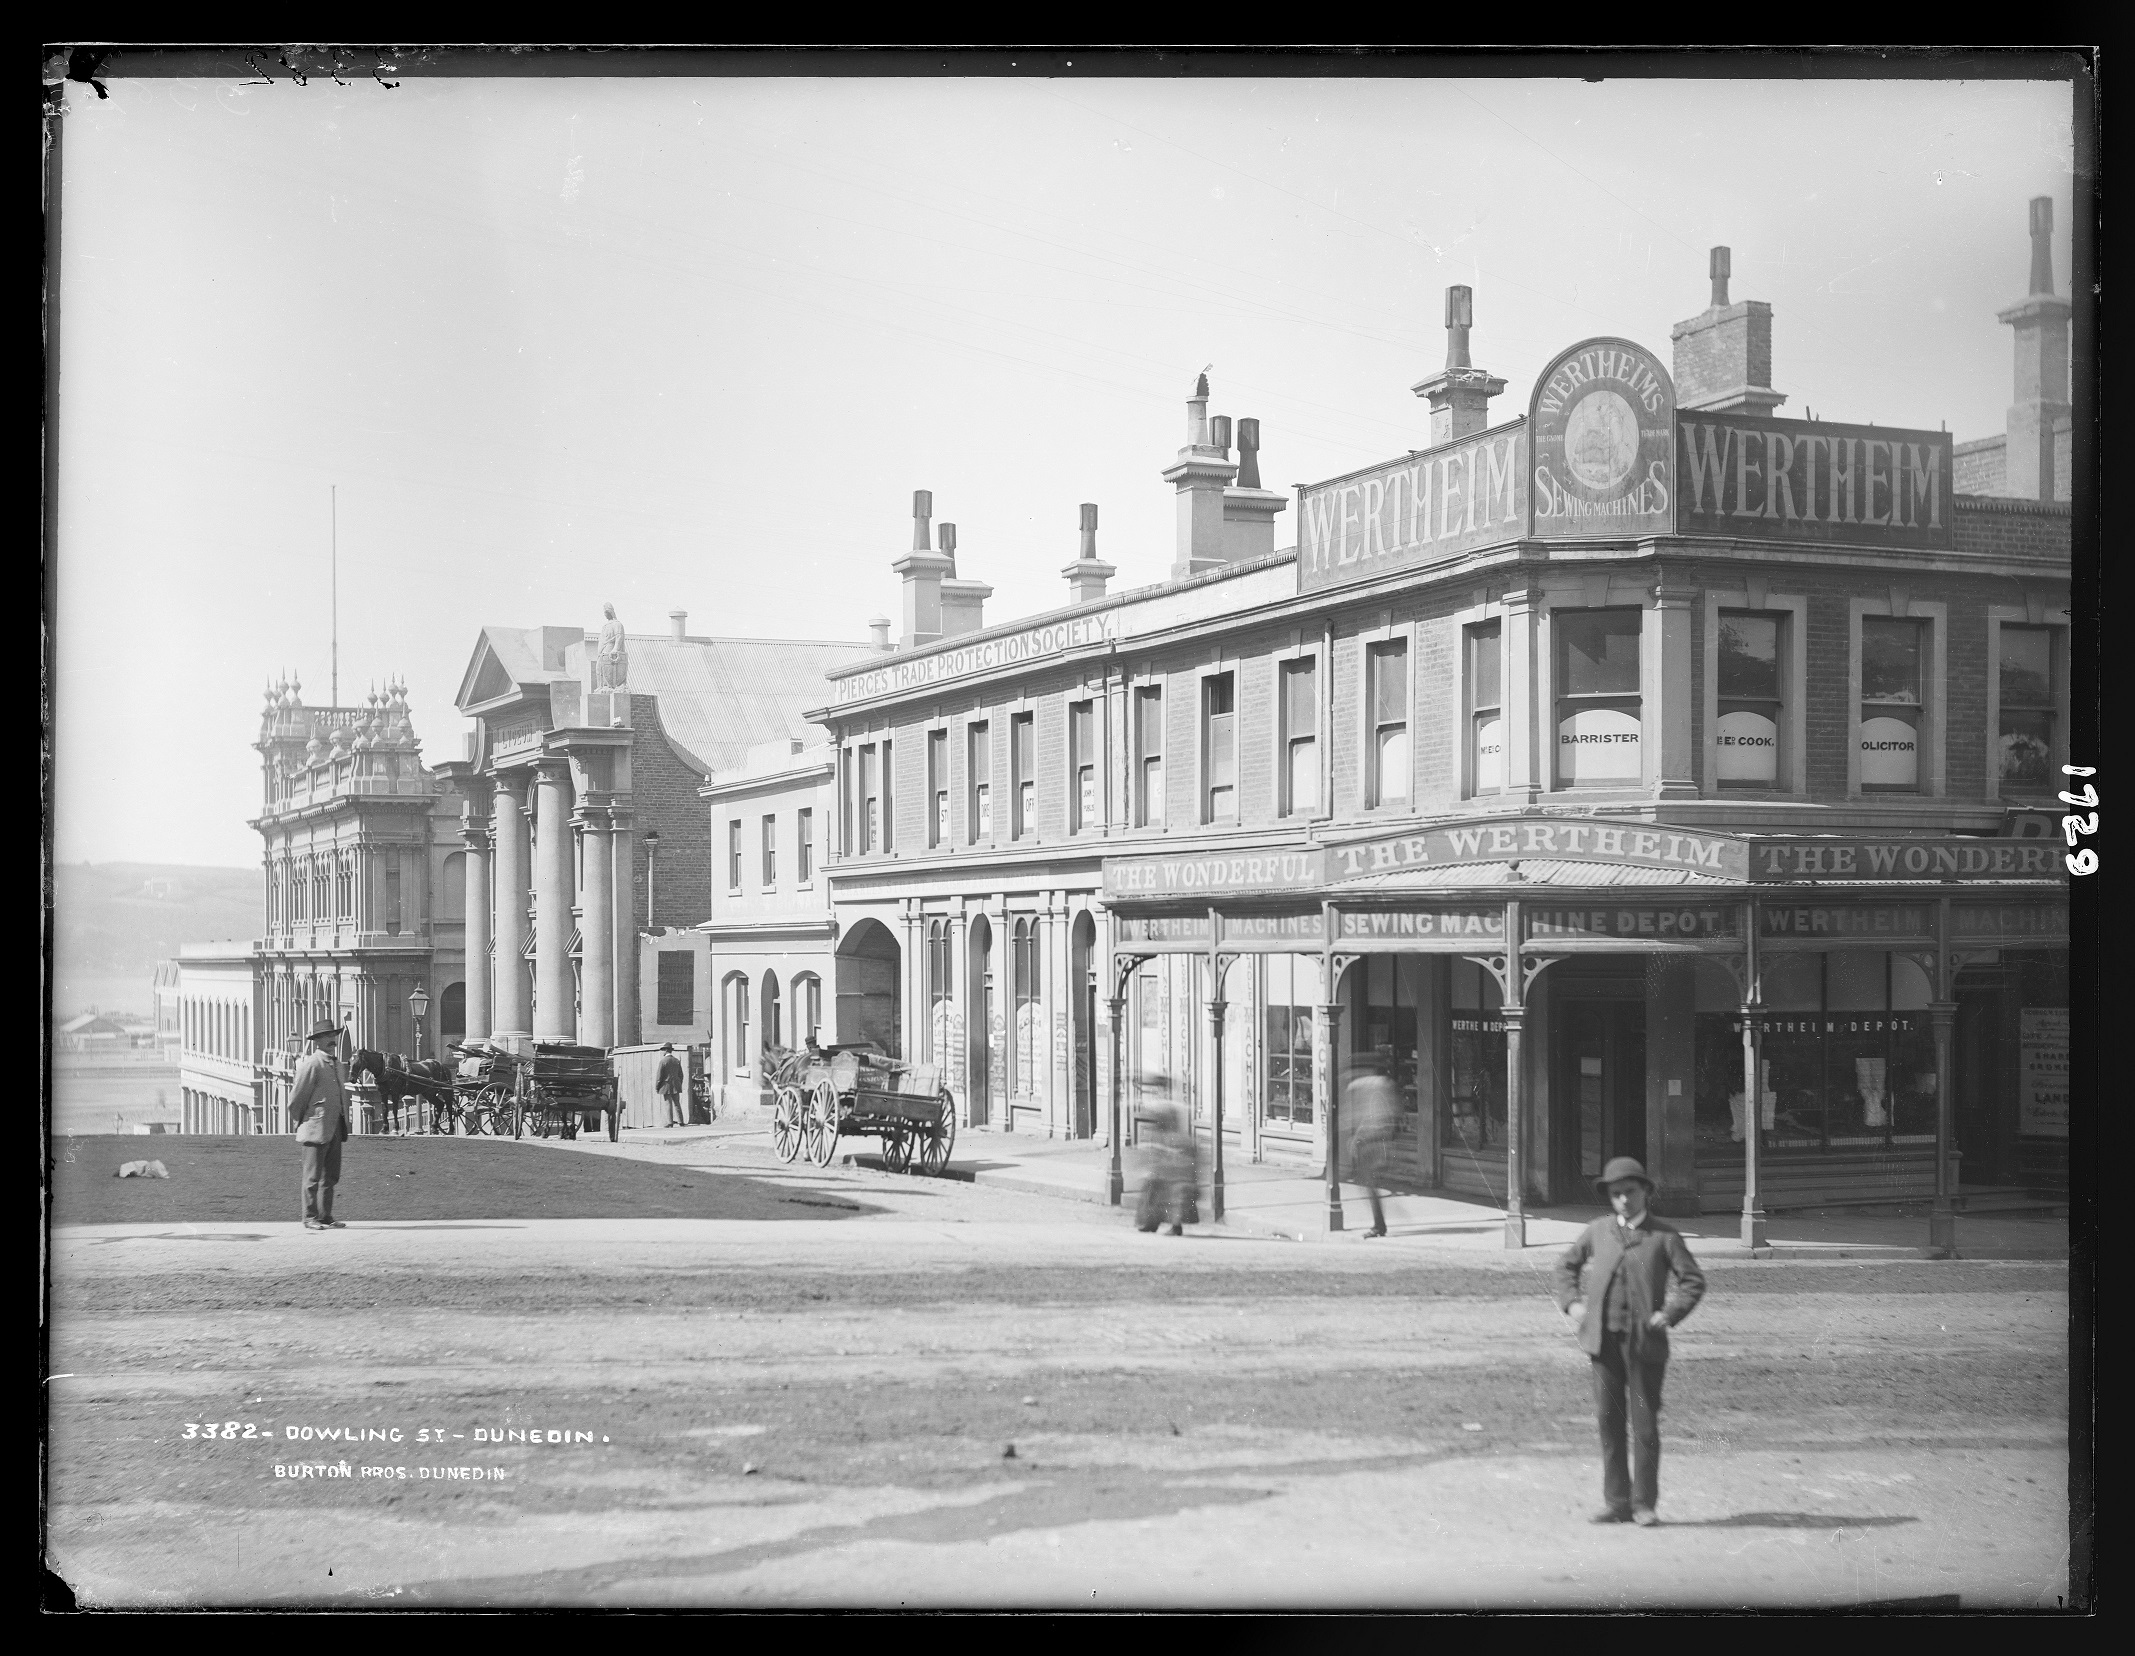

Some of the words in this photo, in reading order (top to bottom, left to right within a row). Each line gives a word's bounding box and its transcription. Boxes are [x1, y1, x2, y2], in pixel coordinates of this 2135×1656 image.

[1680, 422, 1944, 529] WERTHEIM
[1535, 465, 1593, 518] SEWING
[1593, 460, 1668, 517] MACHINES
[1304, 435, 1518, 573] WERTHEIM
[892, 658, 935, 689] TRADE
[937, 636, 1030, 680] PROTECTION
[1561, 733, 1639, 744] BARRISTER
[1738, 736, 1775, 747] COOK.
[1337, 836, 1430, 875] THE
[1444, 824, 1726, 869] WERTHEIM
[1760, 846, 1857, 875] THE
[1112, 864, 1157, 891] THE
[1162, 853, 1316, 889] WONDERFUL
[1129, 916, 1209, 937] WERTHEIM
[1231, 914, 1323, 935] MACHINES
[1344, 912, 1434, 935] SEWING
[1767, 909, 1922, 932] WERTHEIM
[1733, 1021, 1834, 1033] WRTHEIM
